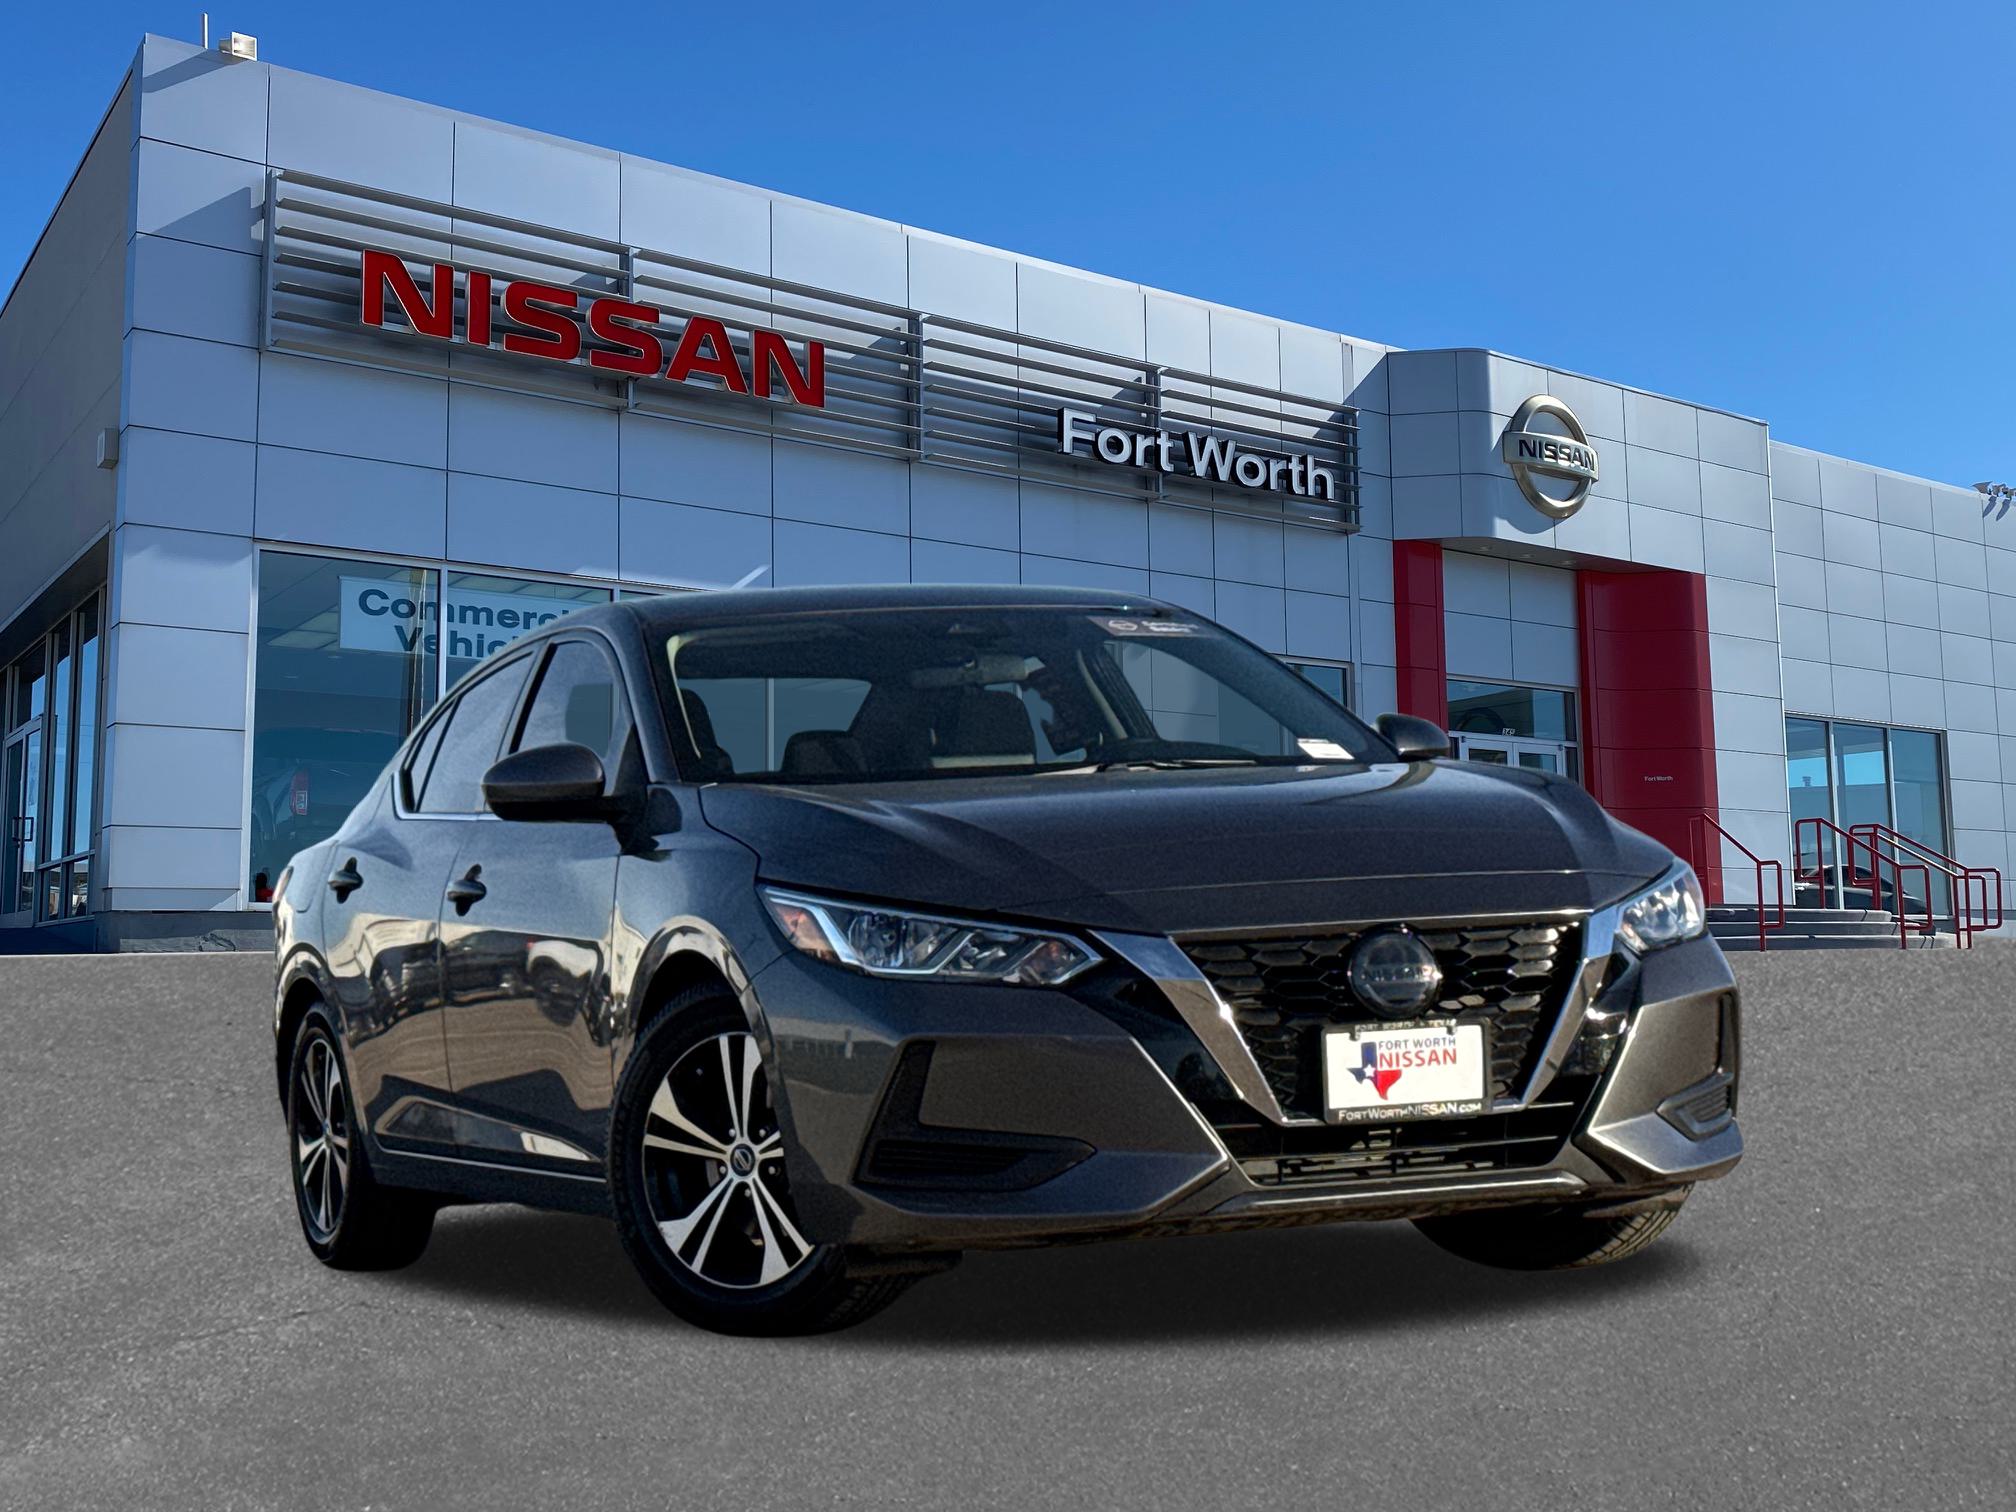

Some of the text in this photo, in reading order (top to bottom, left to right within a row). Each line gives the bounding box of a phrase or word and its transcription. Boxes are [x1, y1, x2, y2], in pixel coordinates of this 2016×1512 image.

[361, 249, 825, 408] NISSAN
[1059, 407, 1336, 500] Fort Worth
[1518, 439, 1595, 472] NISSAN
[1378, 1037, 1456, 1050] FORT WORTH
[1379, 1048, 1457, 1069] NISSAN
